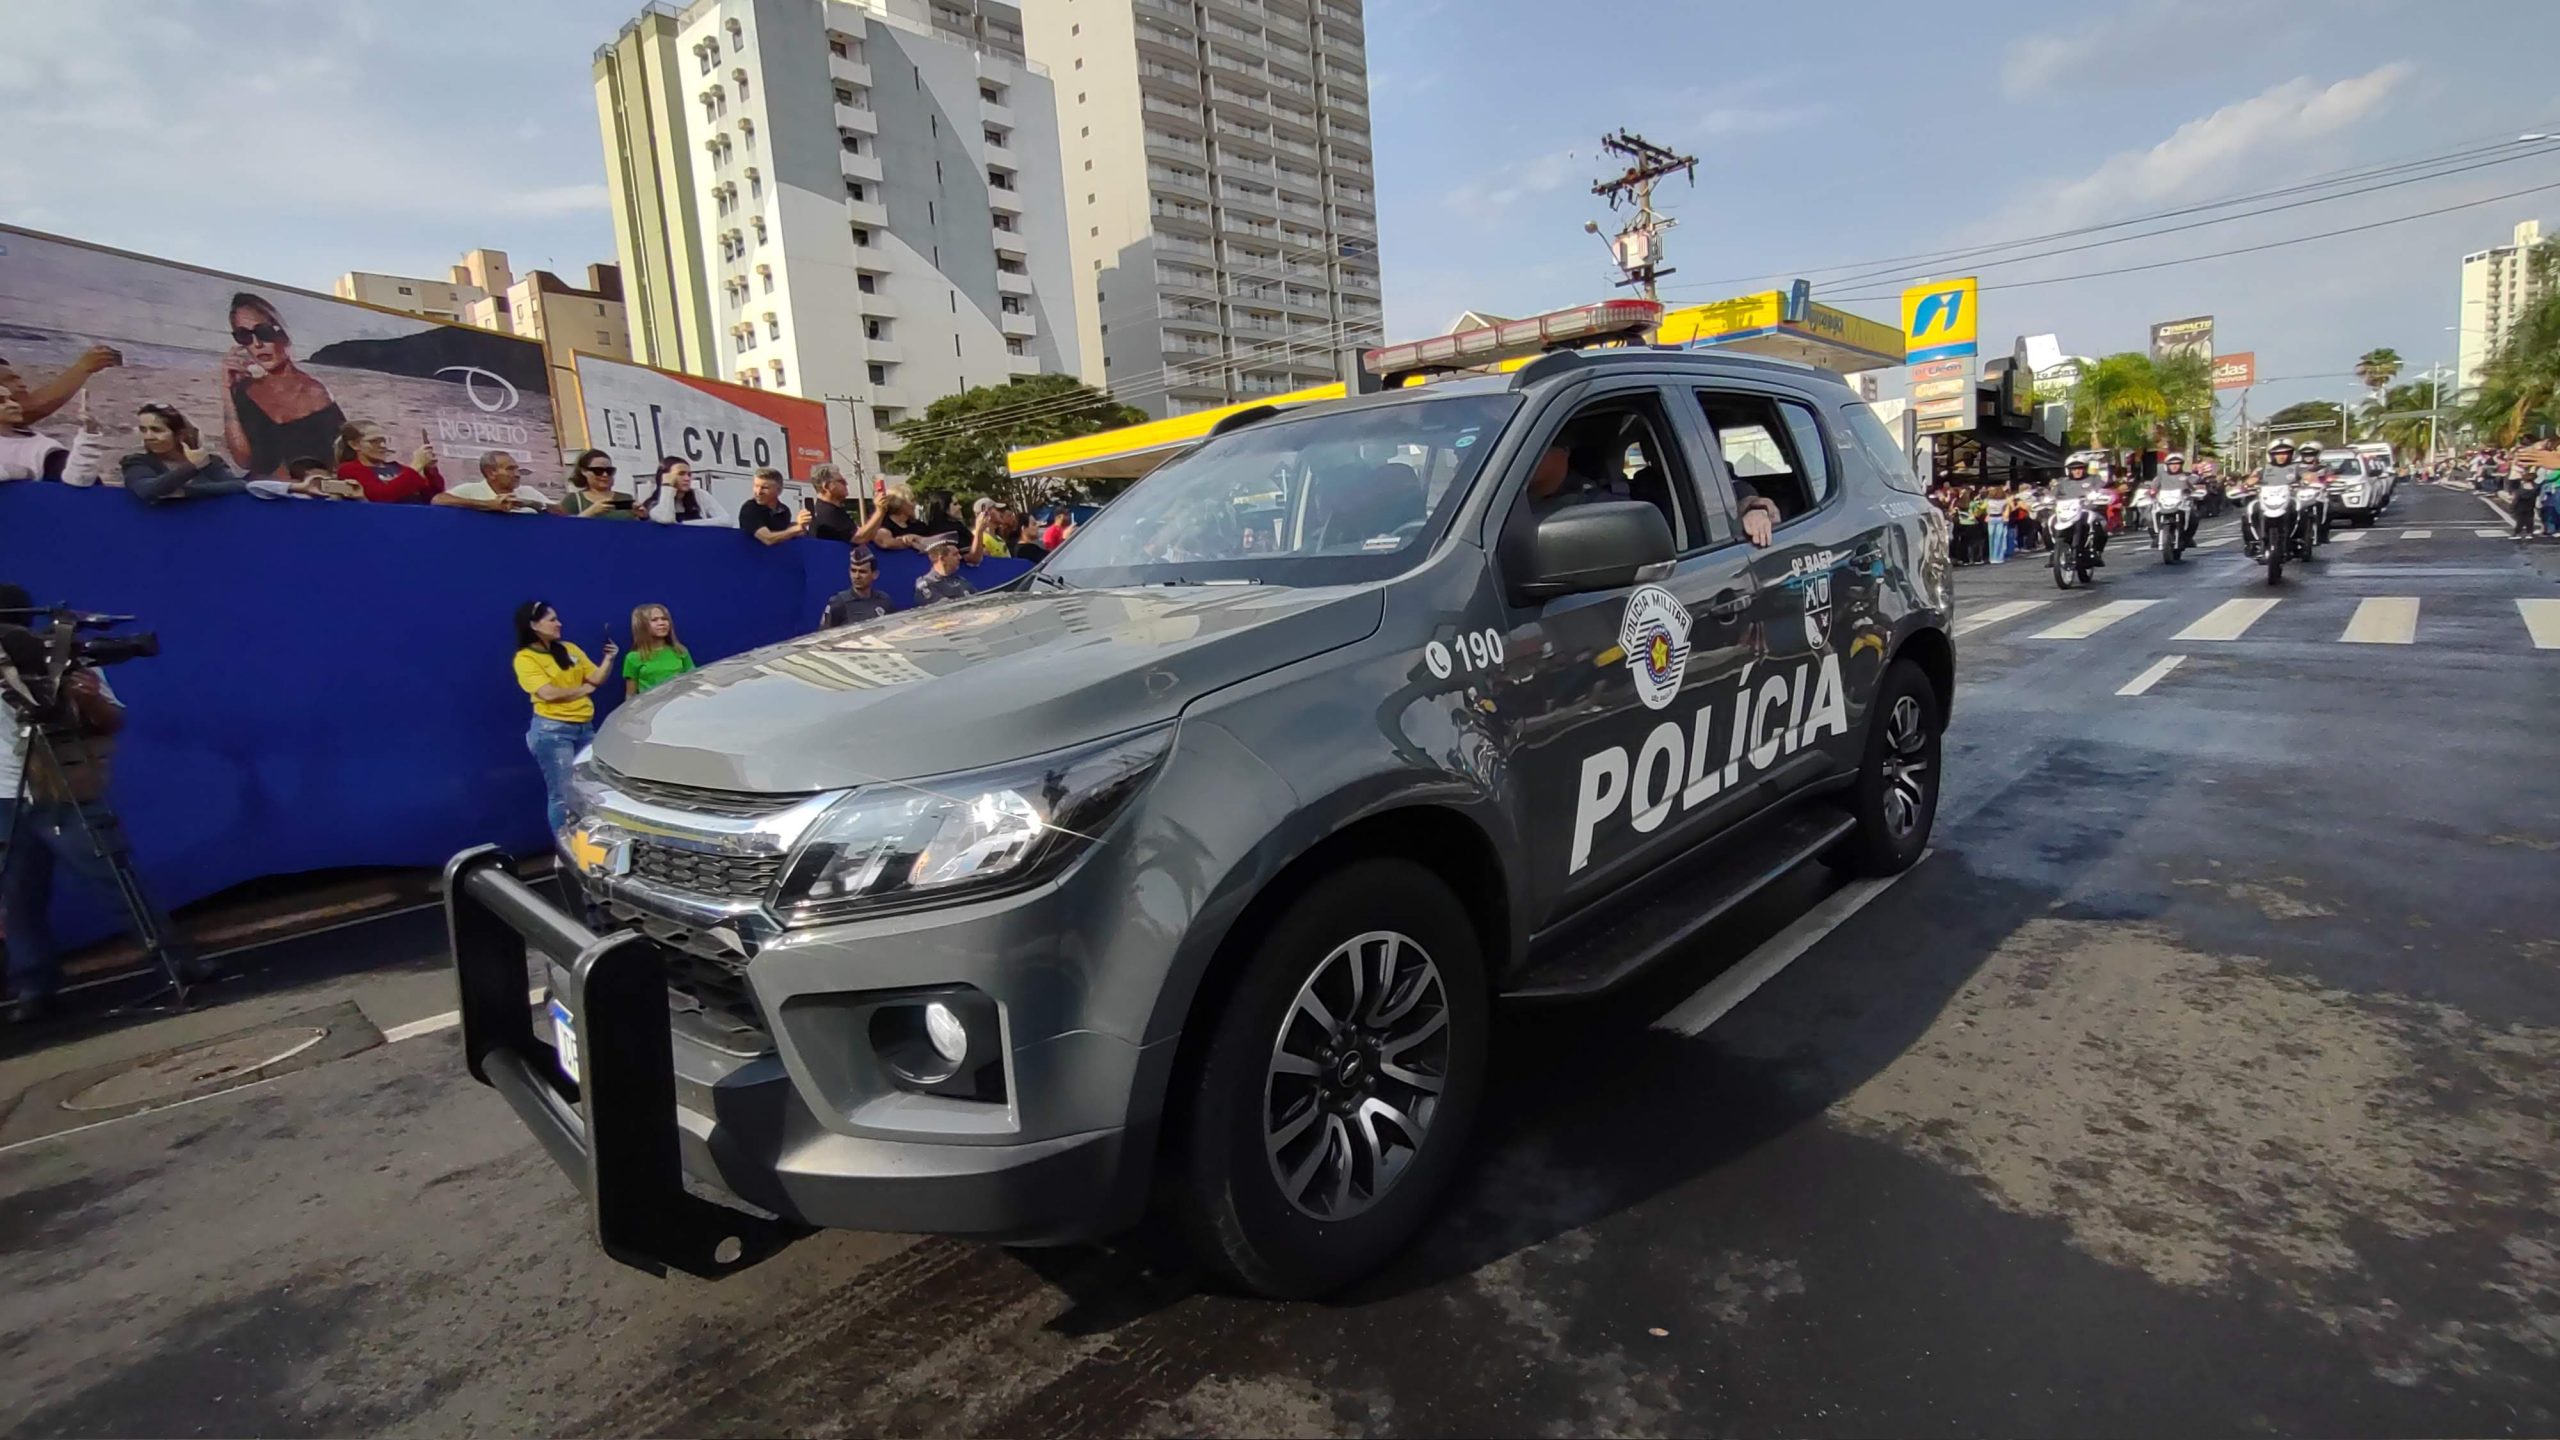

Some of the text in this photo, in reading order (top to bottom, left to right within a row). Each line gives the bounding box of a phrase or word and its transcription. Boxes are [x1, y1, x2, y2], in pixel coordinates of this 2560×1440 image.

[438, 418, 472, 441] RIO
[682, 426, 772, 468] CYLO
[1804, 550, 1833, 574] BAEP
[1651, 592, 1688, 631] MILITAR
[1455, 627, 1504, 672] 190
[1569, 652, 1849, 877] POLÍCIA
